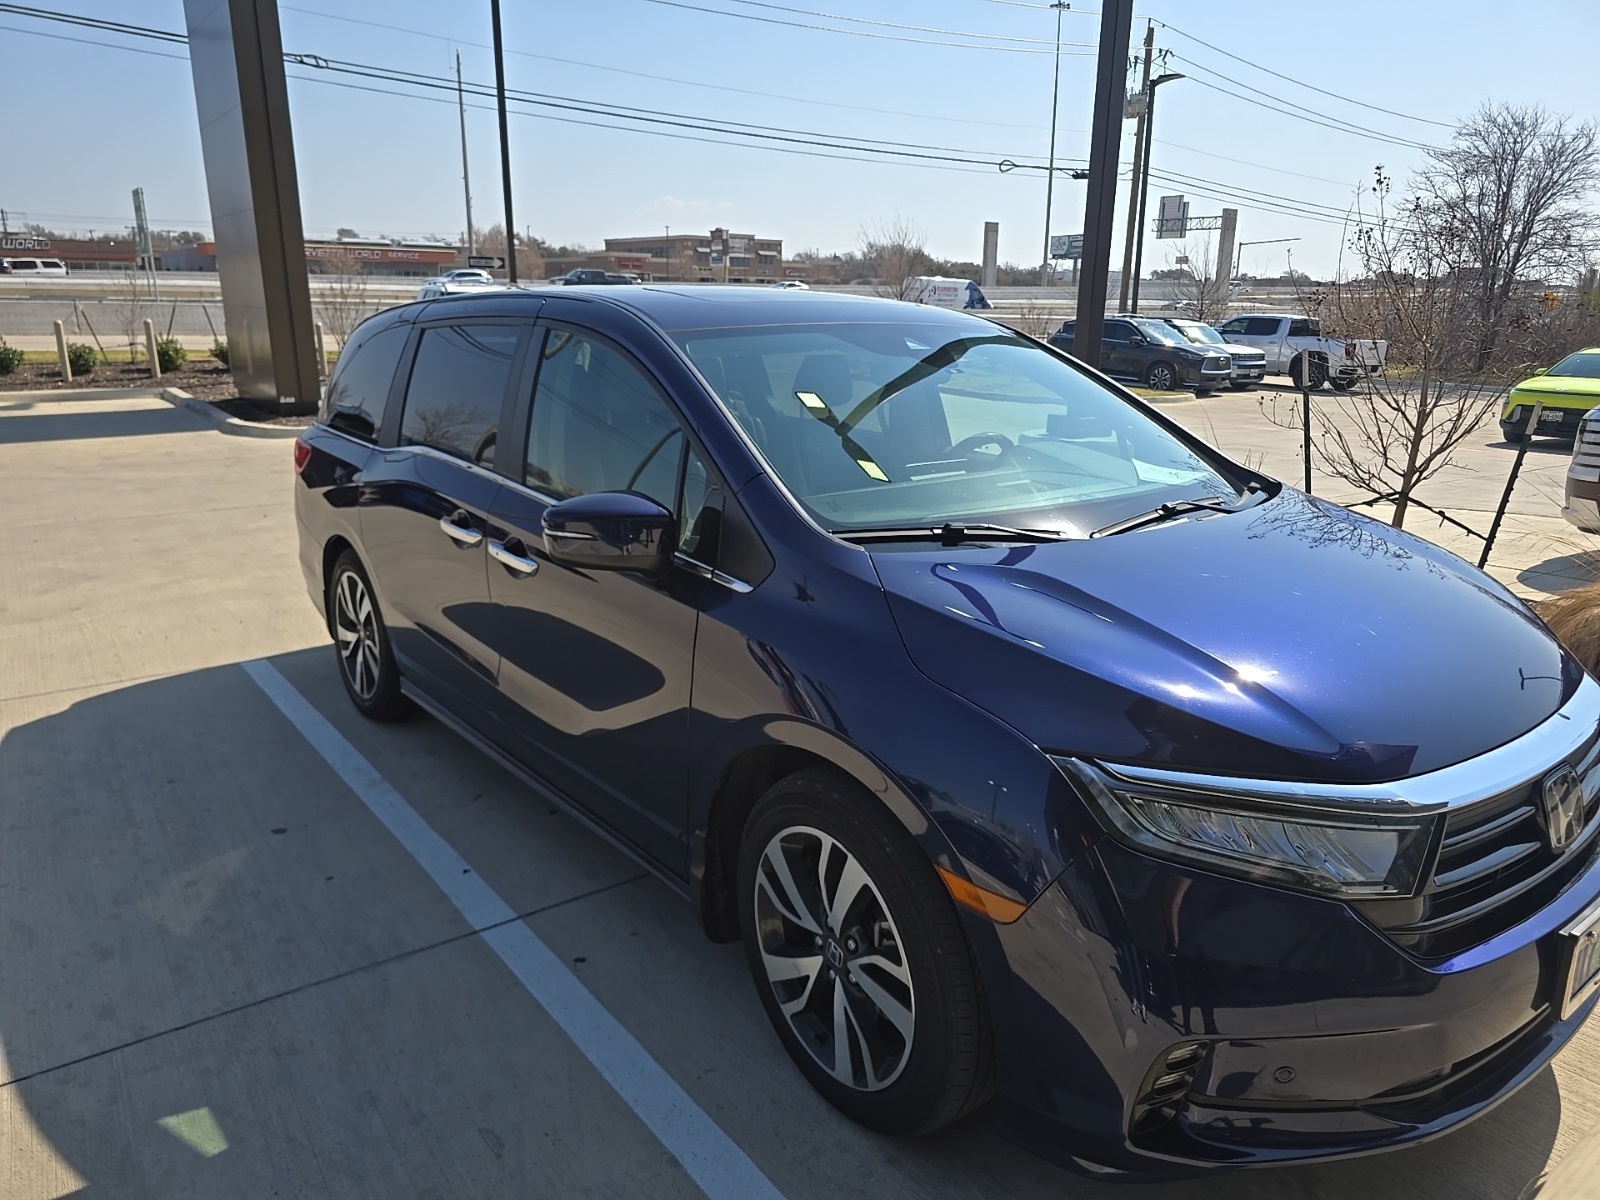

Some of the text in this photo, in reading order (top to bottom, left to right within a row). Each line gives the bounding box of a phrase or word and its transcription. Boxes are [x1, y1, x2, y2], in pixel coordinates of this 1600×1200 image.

[2, 239, 51, 250] WORLD
[347, 249, 381, 258] WORLD
[388, 251, 420, 260] SERVICE
